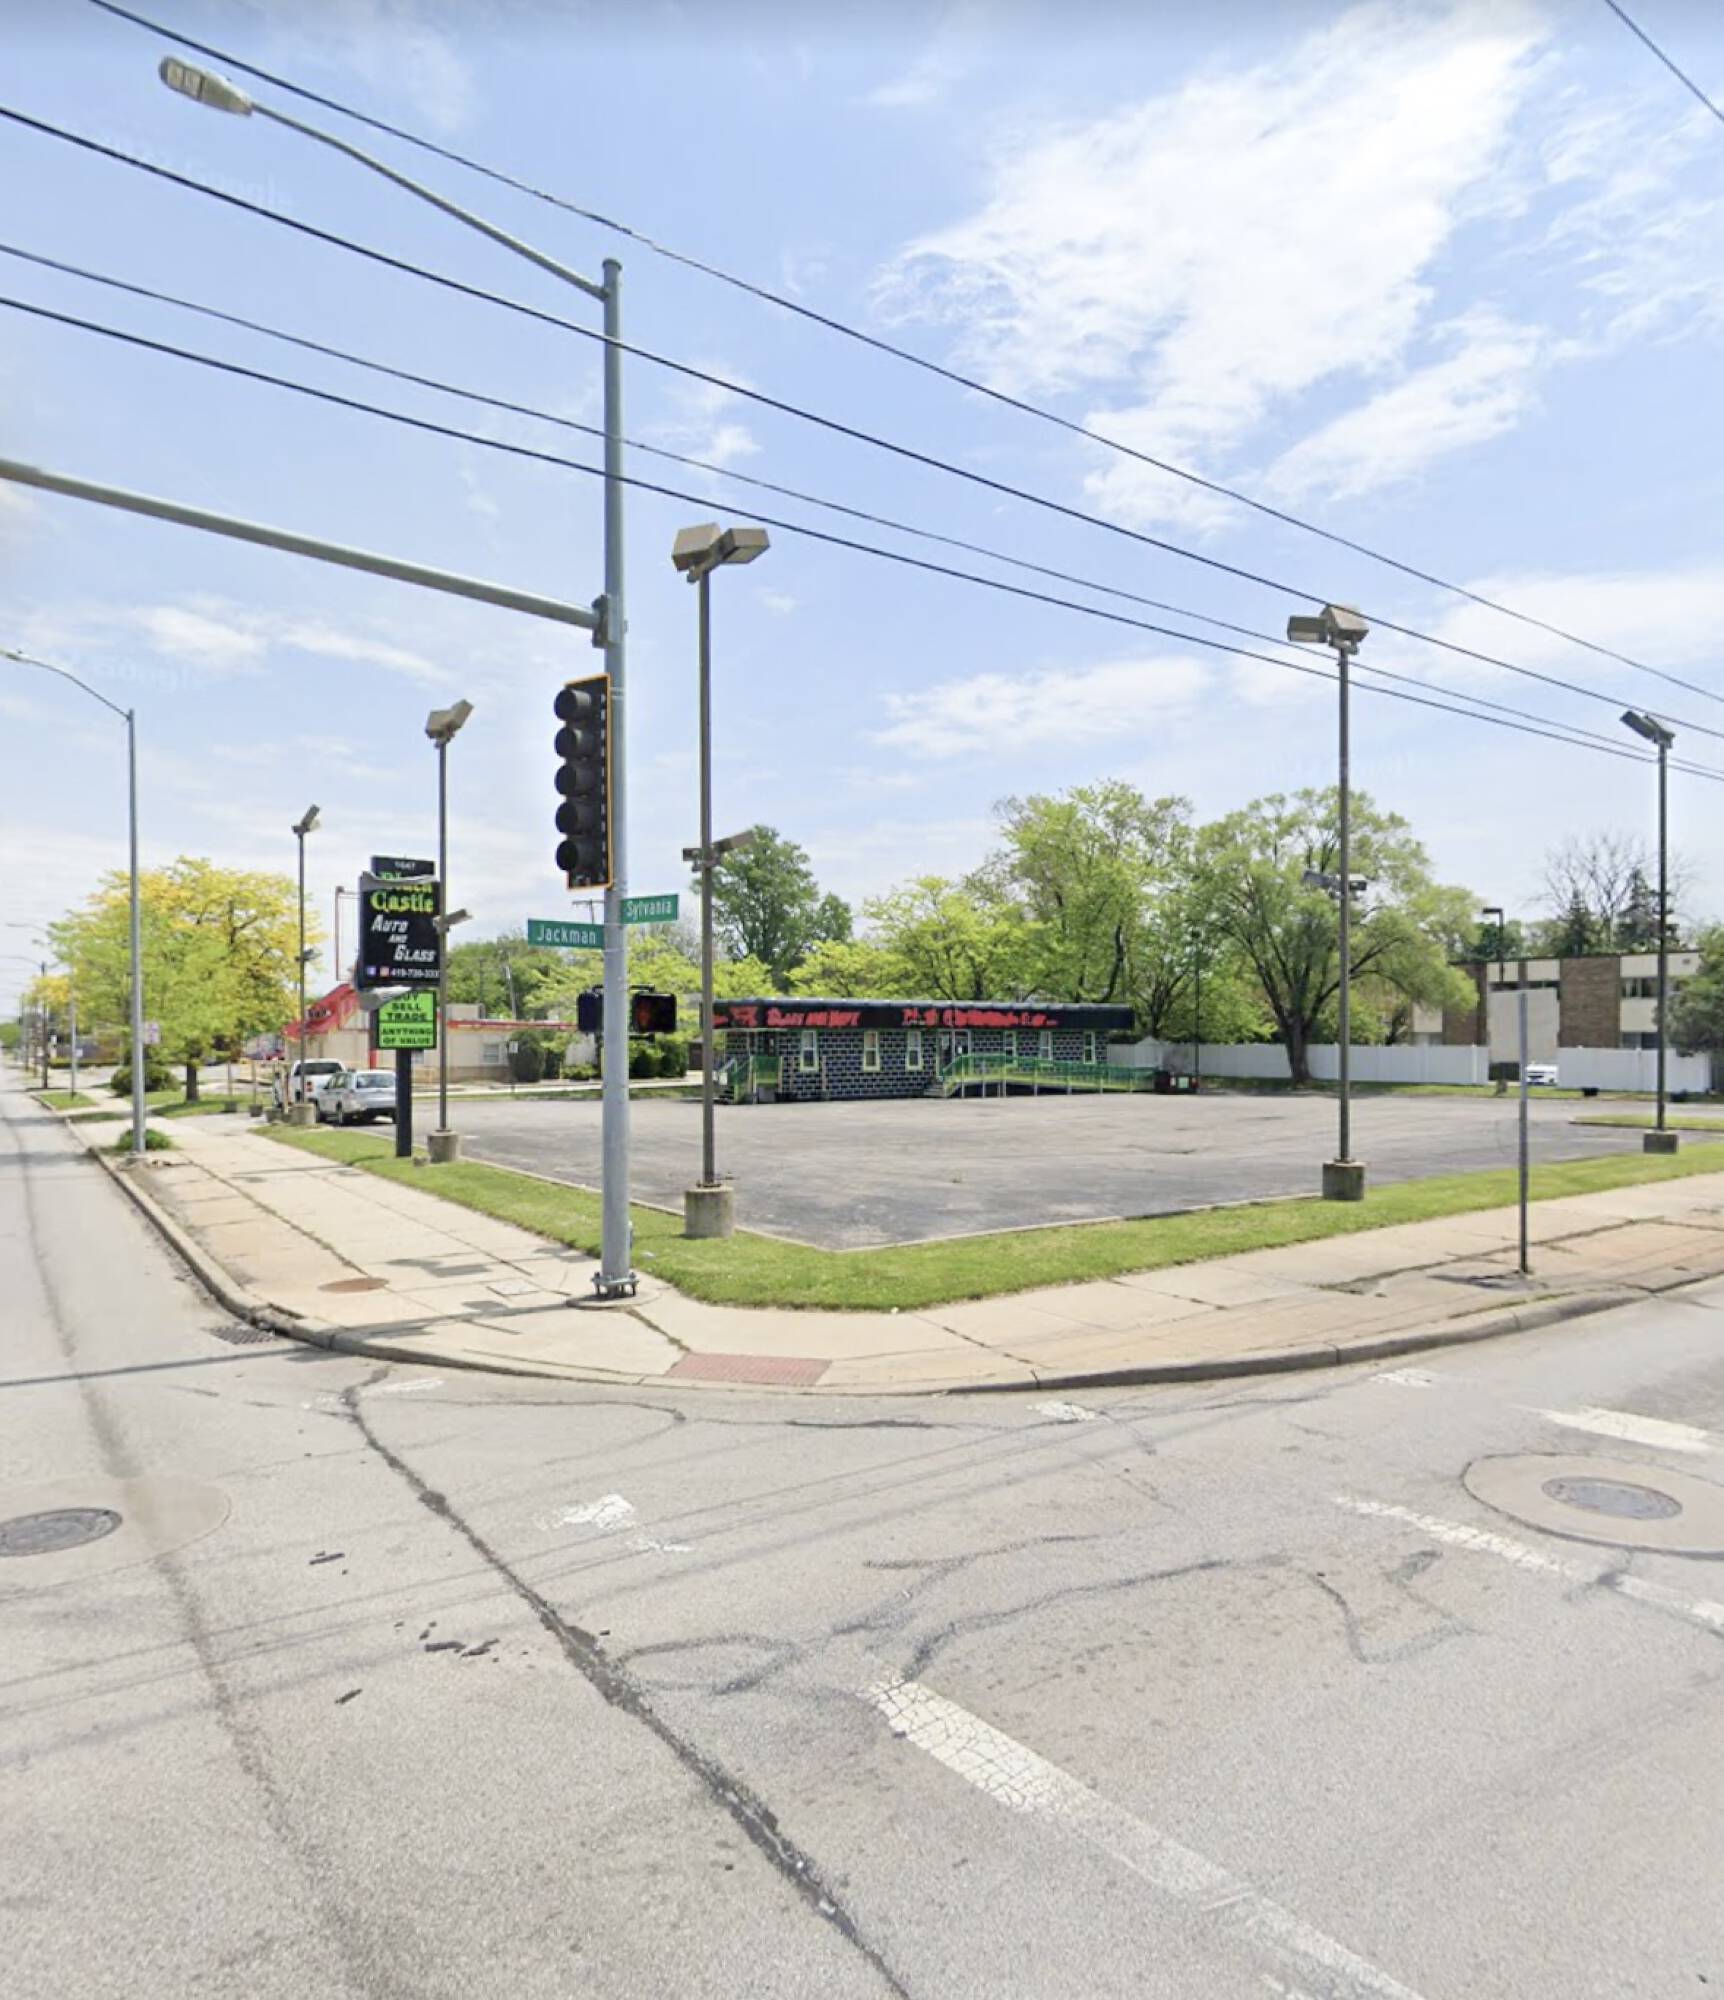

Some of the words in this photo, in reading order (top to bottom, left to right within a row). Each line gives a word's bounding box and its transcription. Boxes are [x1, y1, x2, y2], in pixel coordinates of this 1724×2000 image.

[370, 890, 434, 913] Castle
[626, 900, 672, 920] Sylvania
[536, 924, 597, 945] Jackman
[391, 1002, 423, 1011] SELL
